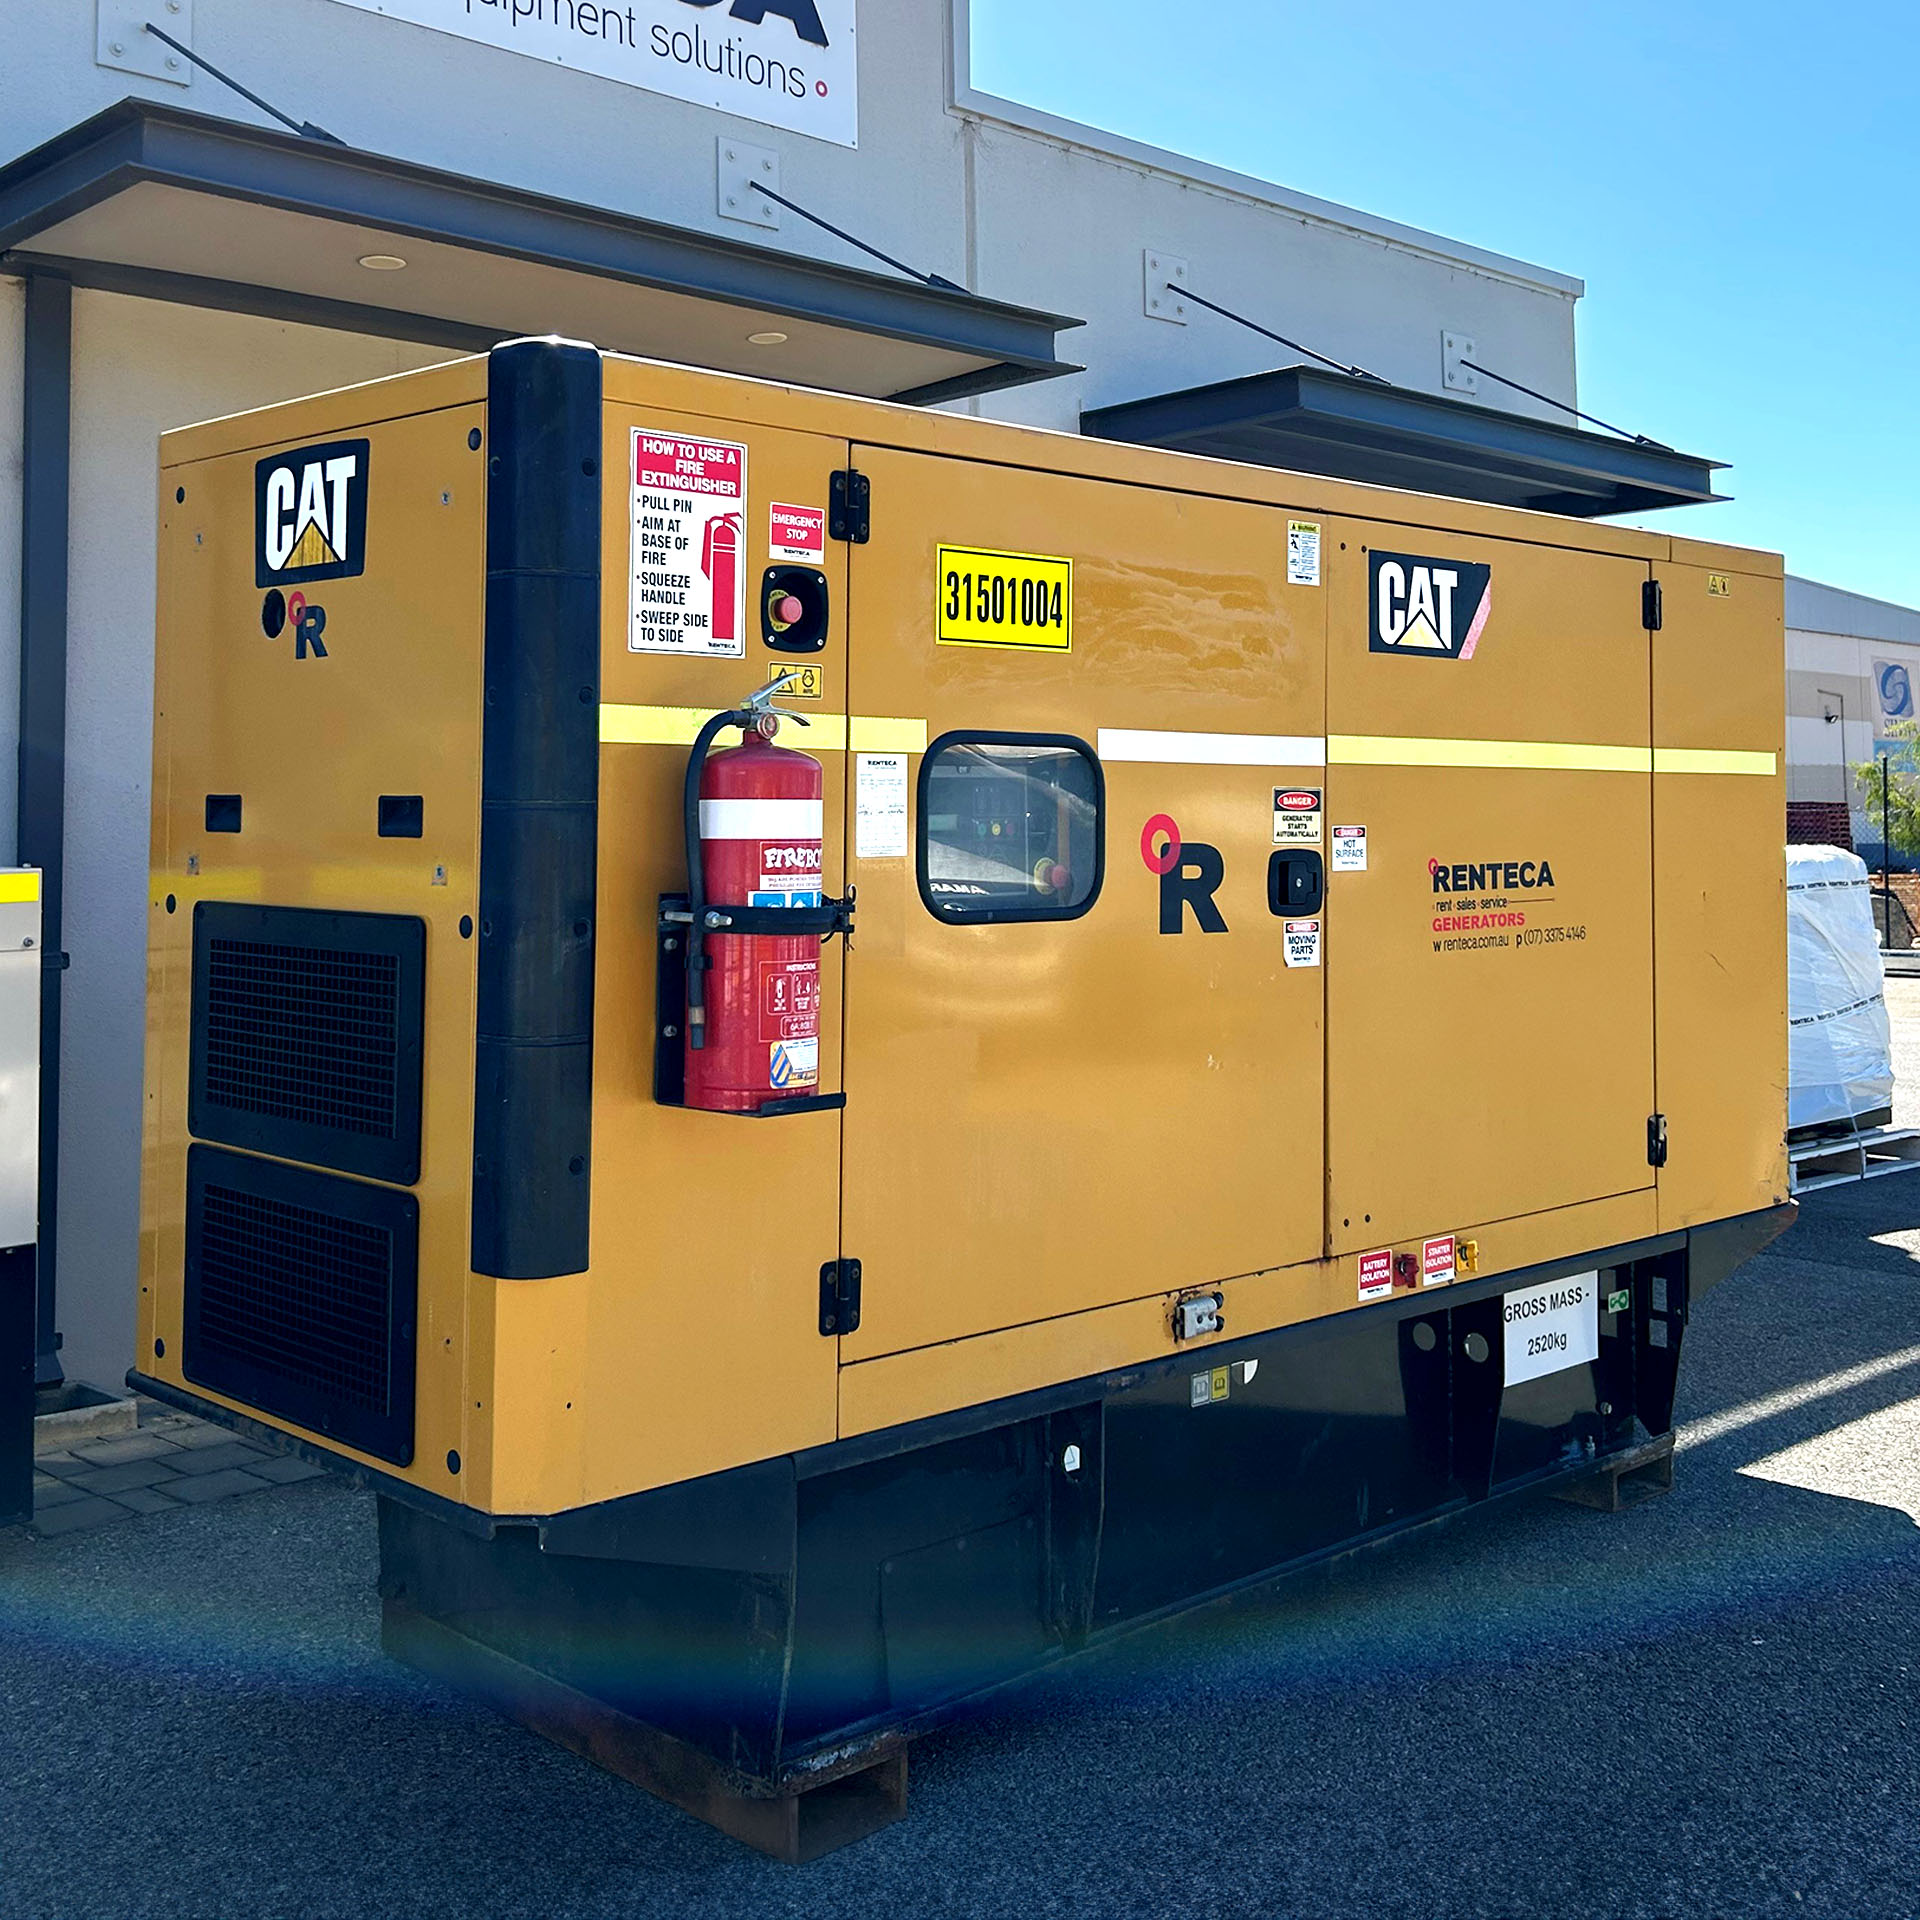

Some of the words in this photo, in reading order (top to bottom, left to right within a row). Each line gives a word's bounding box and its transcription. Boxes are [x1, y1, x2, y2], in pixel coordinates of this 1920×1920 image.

[650, 24, 806, 98] solutions
[642, 438, 675, 456] HOW
[677, 443, 696, 459] TO
[698, 446, 724, 463] USE
[726, 451, 736, 465] A
[675, 459, 705, 476] FIRE
[641, 469, 736, 495] EXTINGUISHER
[642, 495, 670, 511] PULL
[673, 499, 692, 513] PIN
[266, 455, 356, 571] CAT
[772, 512, 822, 529] EMERGENCY
[641, 516, 664, 530] AIM
[667, 519, 681, 532] AT
[641, 533, 672, 549] BASE
[674, 536, 689, 550] OF
[786, 528, 808, 541] STOP
[641, 550, 667, 566] FIRE
[641, 571, 691, 588] SQUEEZE
[641, 588, 686, 605] HANDLE
[946, 571, 1063, 628] 31501004
[1378, 560, 1458, 650] CAT
[640, 609, 680, 625] SWEEP
[683, 613, 708, 628] SIDE
[640, 627, 655, 641] TO
[658, 628, 684, 643] SIDE
[1283, 797, 1312, 805] DANGER
[1343, 839, 1356, 848] HOT
[1336, 849, 1363, 858] SURFACE
[1431, 860, 1555, 892] RENTECA
[1436, 899, 1452, 912] rent
[1457, 897, 1476, 911] sales
[1480, 895, 1508, 909] service
[1432, 912, 1525, 932] GENERATORS
[1288, 935, 1316, 944] MOVING
[1433, 940, 1441, 952] w
[1443, 935, 1509, 951] renteca.com.au
[1516, 934, 1522, 948] p
[1524, 928, 1543, 945] (07)
[1544, 927, 1564, 943] 3375
[1566, 925, 1586, 940] 4146
[1291, 945, 1313, 954] PARTS
[1428, 1244, 1451, 1257] STARTER
[1363, 1258, 1387, 1271] BATTERY
[1425, 1255, 1452, 1268] ISOLATION
[1361, 1269, 1390, 1283] ISOLATION
[1503, 1297, 1546, 1323] GROSS
[1550, 1287, 1582, 1311] MASS
[1528, 1332, 1567, 1356] 2520kg
